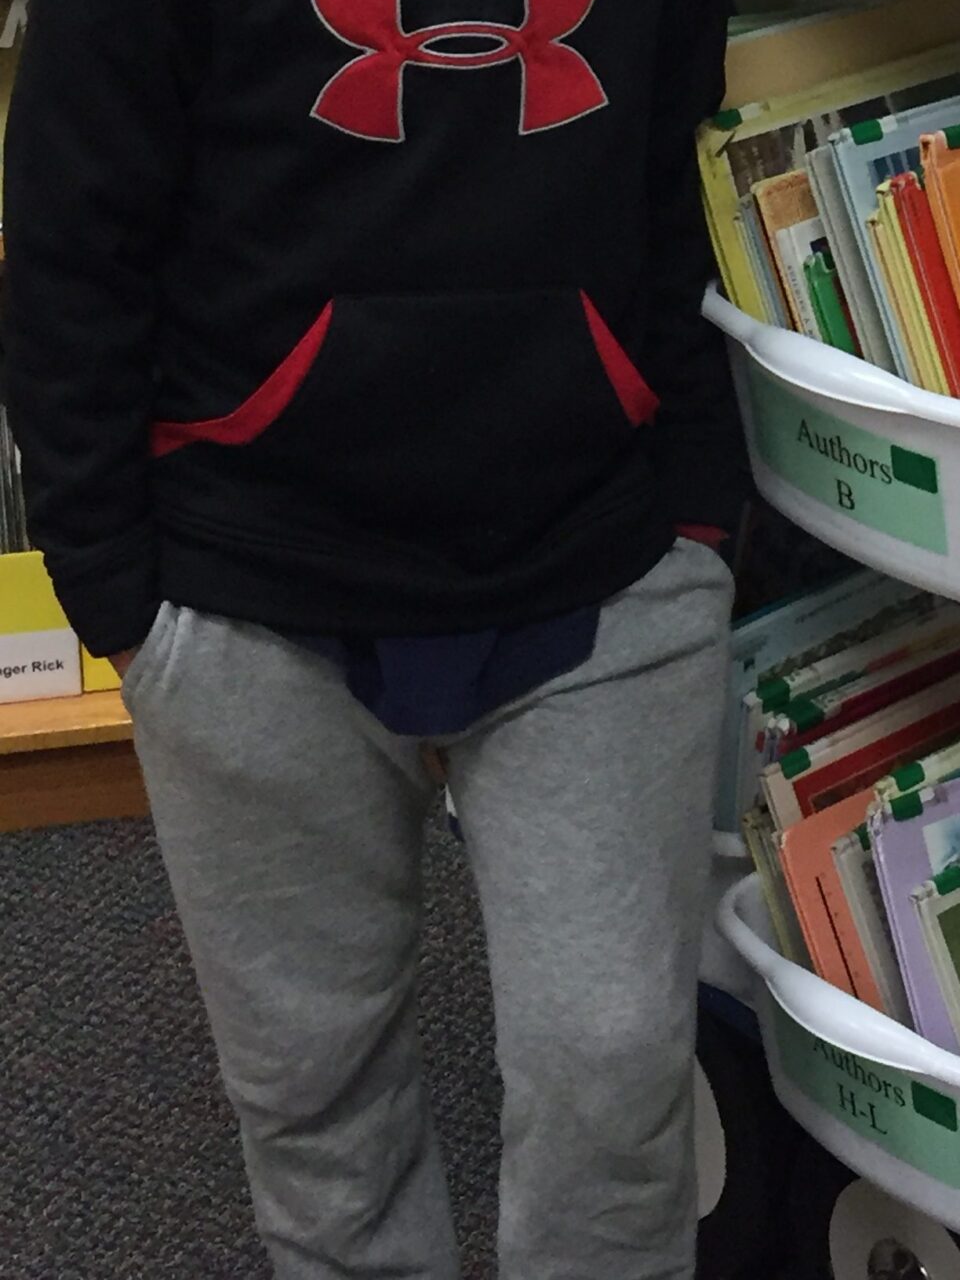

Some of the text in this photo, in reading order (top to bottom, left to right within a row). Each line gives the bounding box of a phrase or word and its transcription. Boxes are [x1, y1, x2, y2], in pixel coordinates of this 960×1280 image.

[798, 418, 892, 485] Authors
[834, 477, 856, 510] B
[31, 660, 64, 672] Rick
[837, 1082, 888, 1135] H-L
